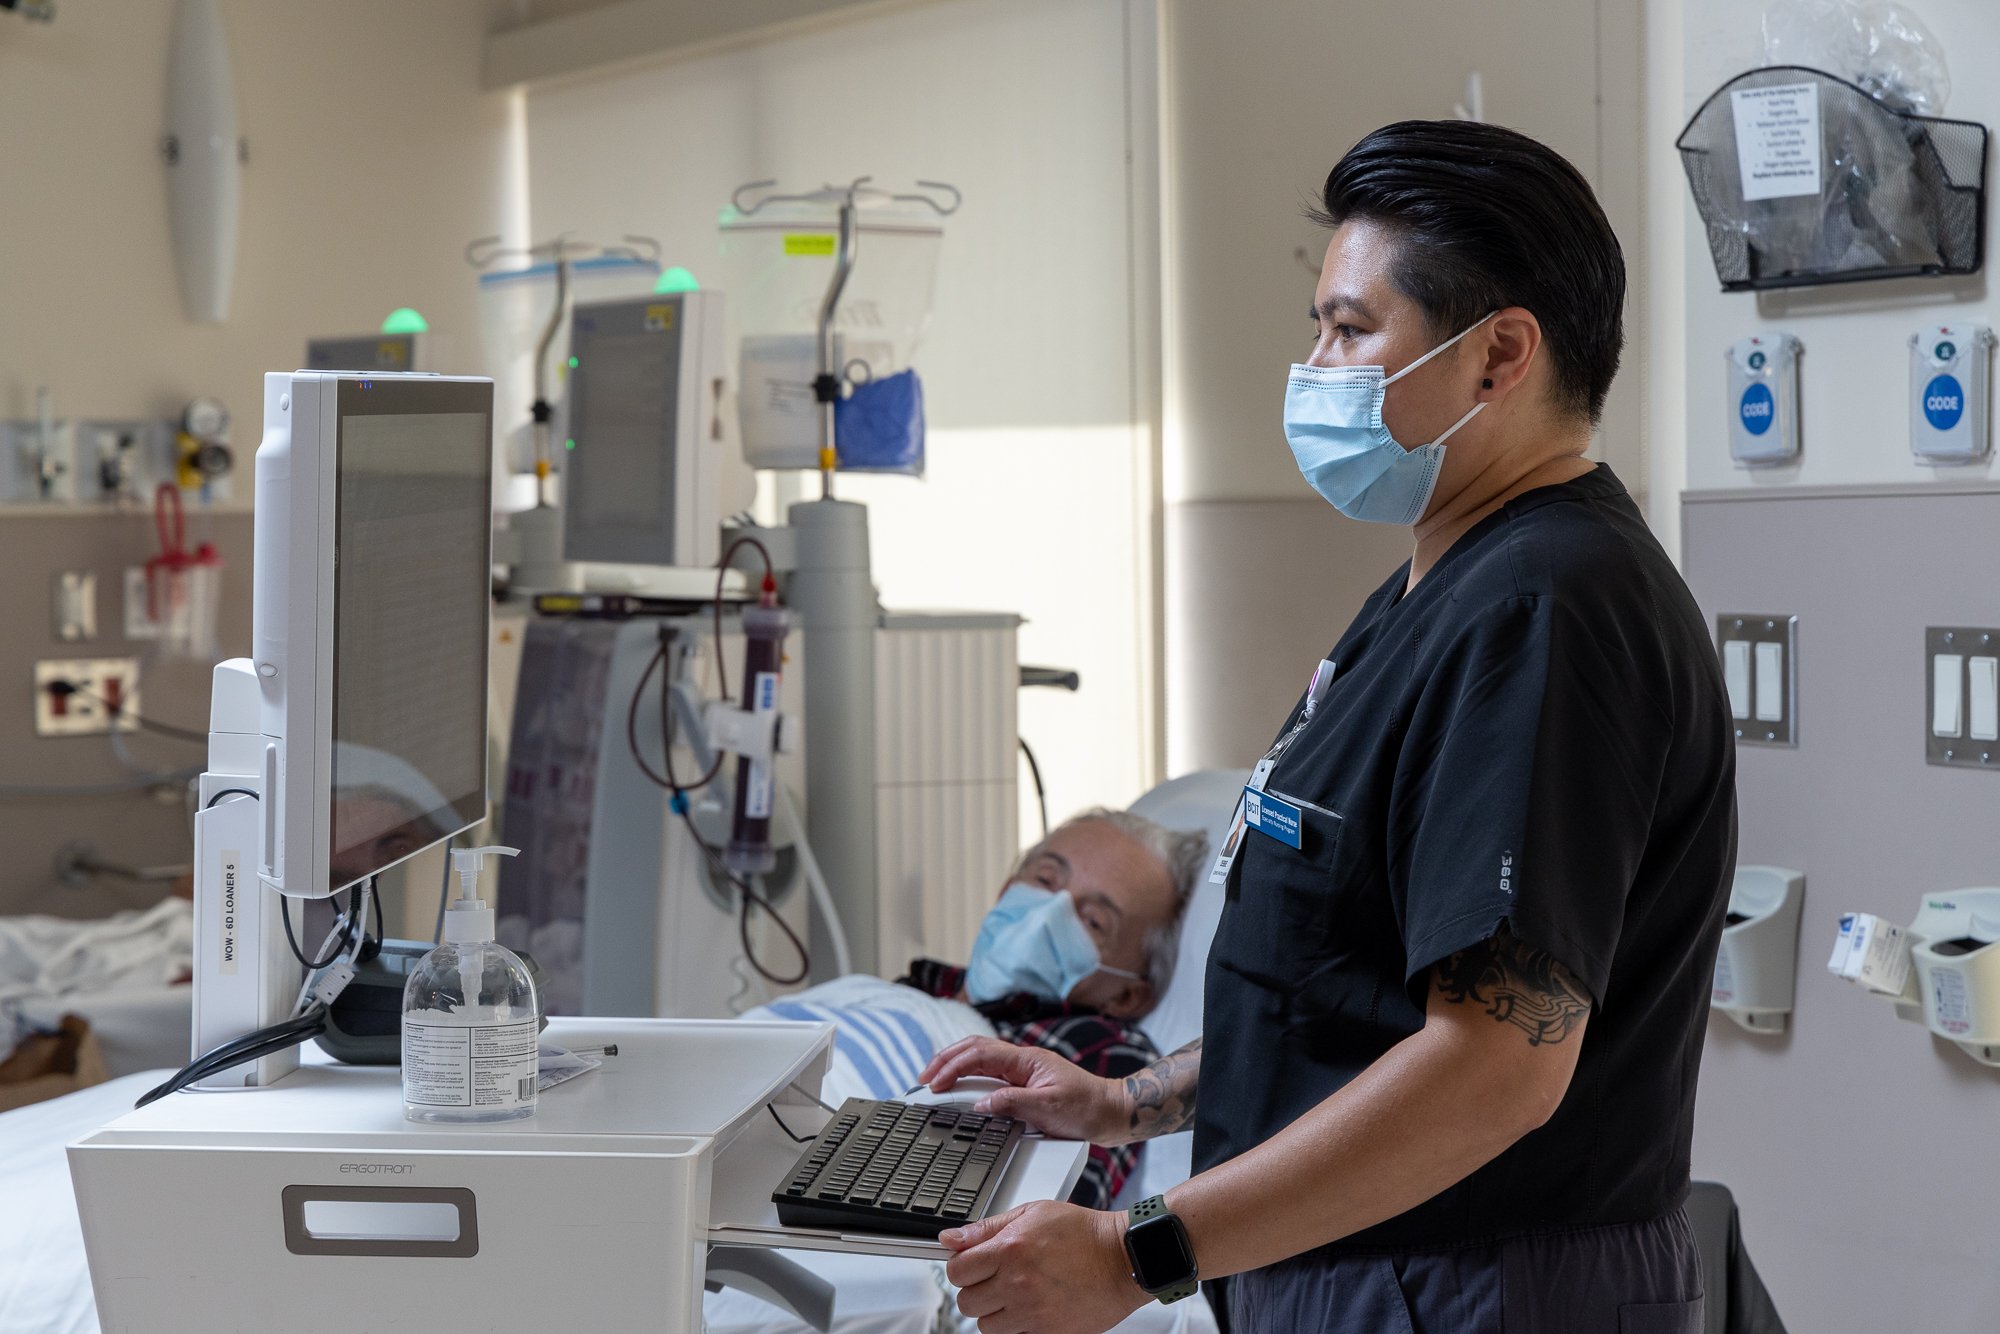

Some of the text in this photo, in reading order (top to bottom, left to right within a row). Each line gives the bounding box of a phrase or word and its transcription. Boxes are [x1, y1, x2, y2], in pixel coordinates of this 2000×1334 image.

[1743, 401, 1770, 417] CODE
[1927, 396, 1959, 410] CODE
[1247, 800, 1259, 815] BCIT
[226, 872, 235, 913] LOANER
[225, 917, 234, 929] 6D
[225, 938, 234, 961] WOW
